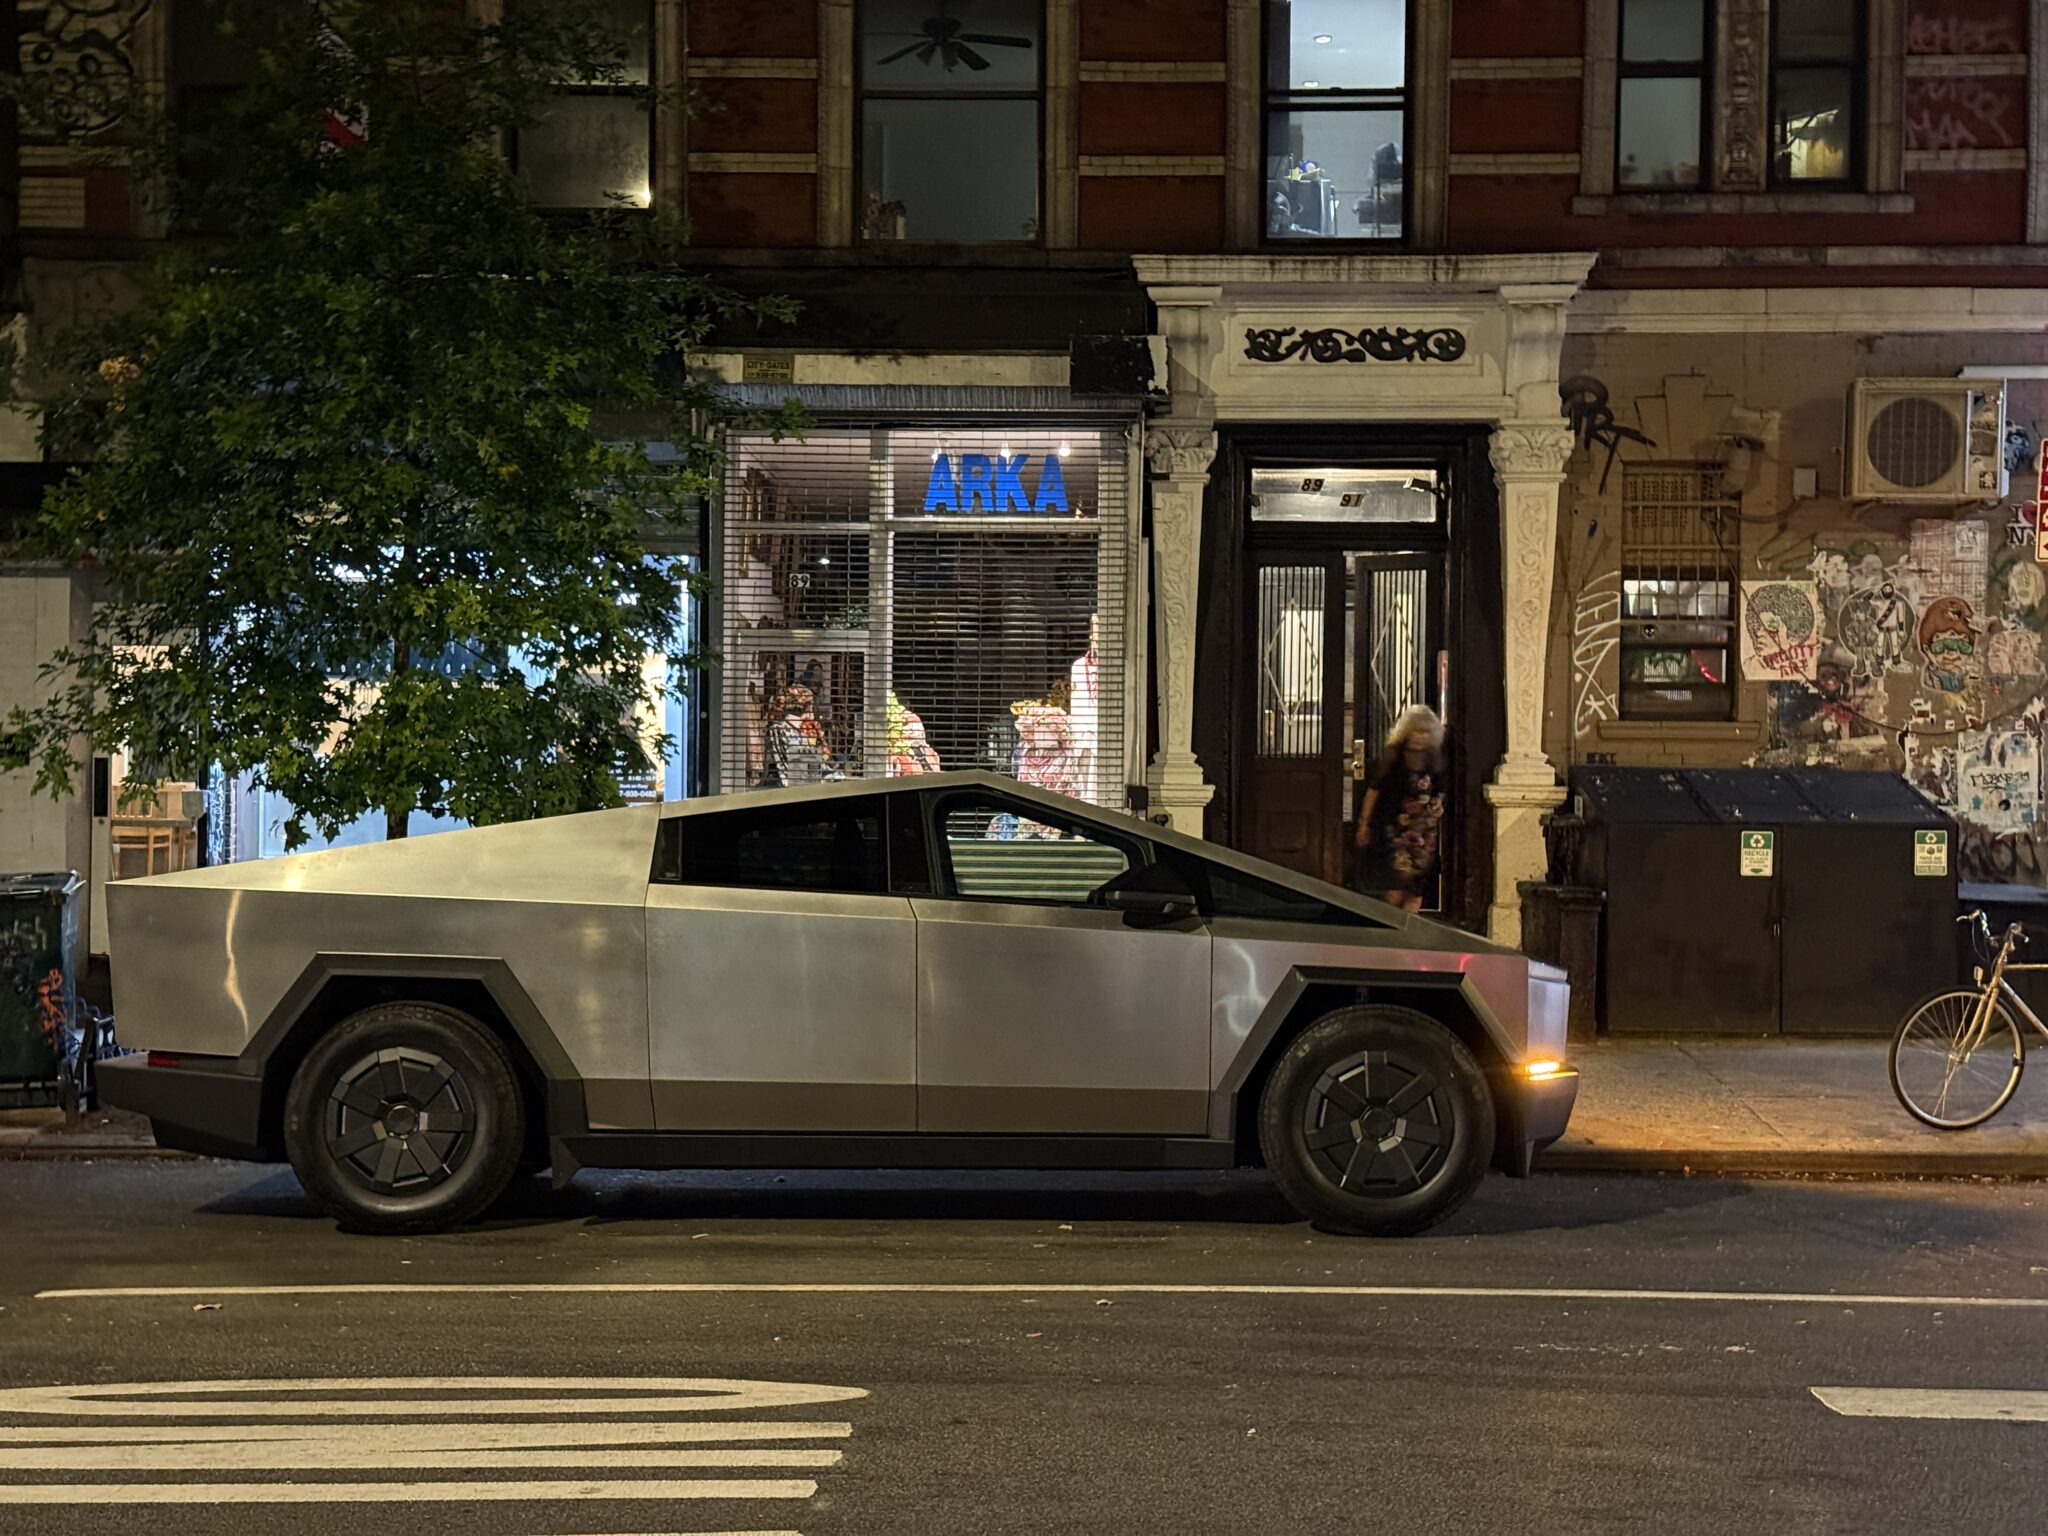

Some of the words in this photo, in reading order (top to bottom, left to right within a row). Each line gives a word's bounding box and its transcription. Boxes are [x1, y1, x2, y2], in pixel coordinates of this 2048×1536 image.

[924, 453, 1069, 513] ARKA
[1301, 479, 1324, 492] 89
[1340, 494, 1362, 507] 91
[790, 574, 810, 588] 89
